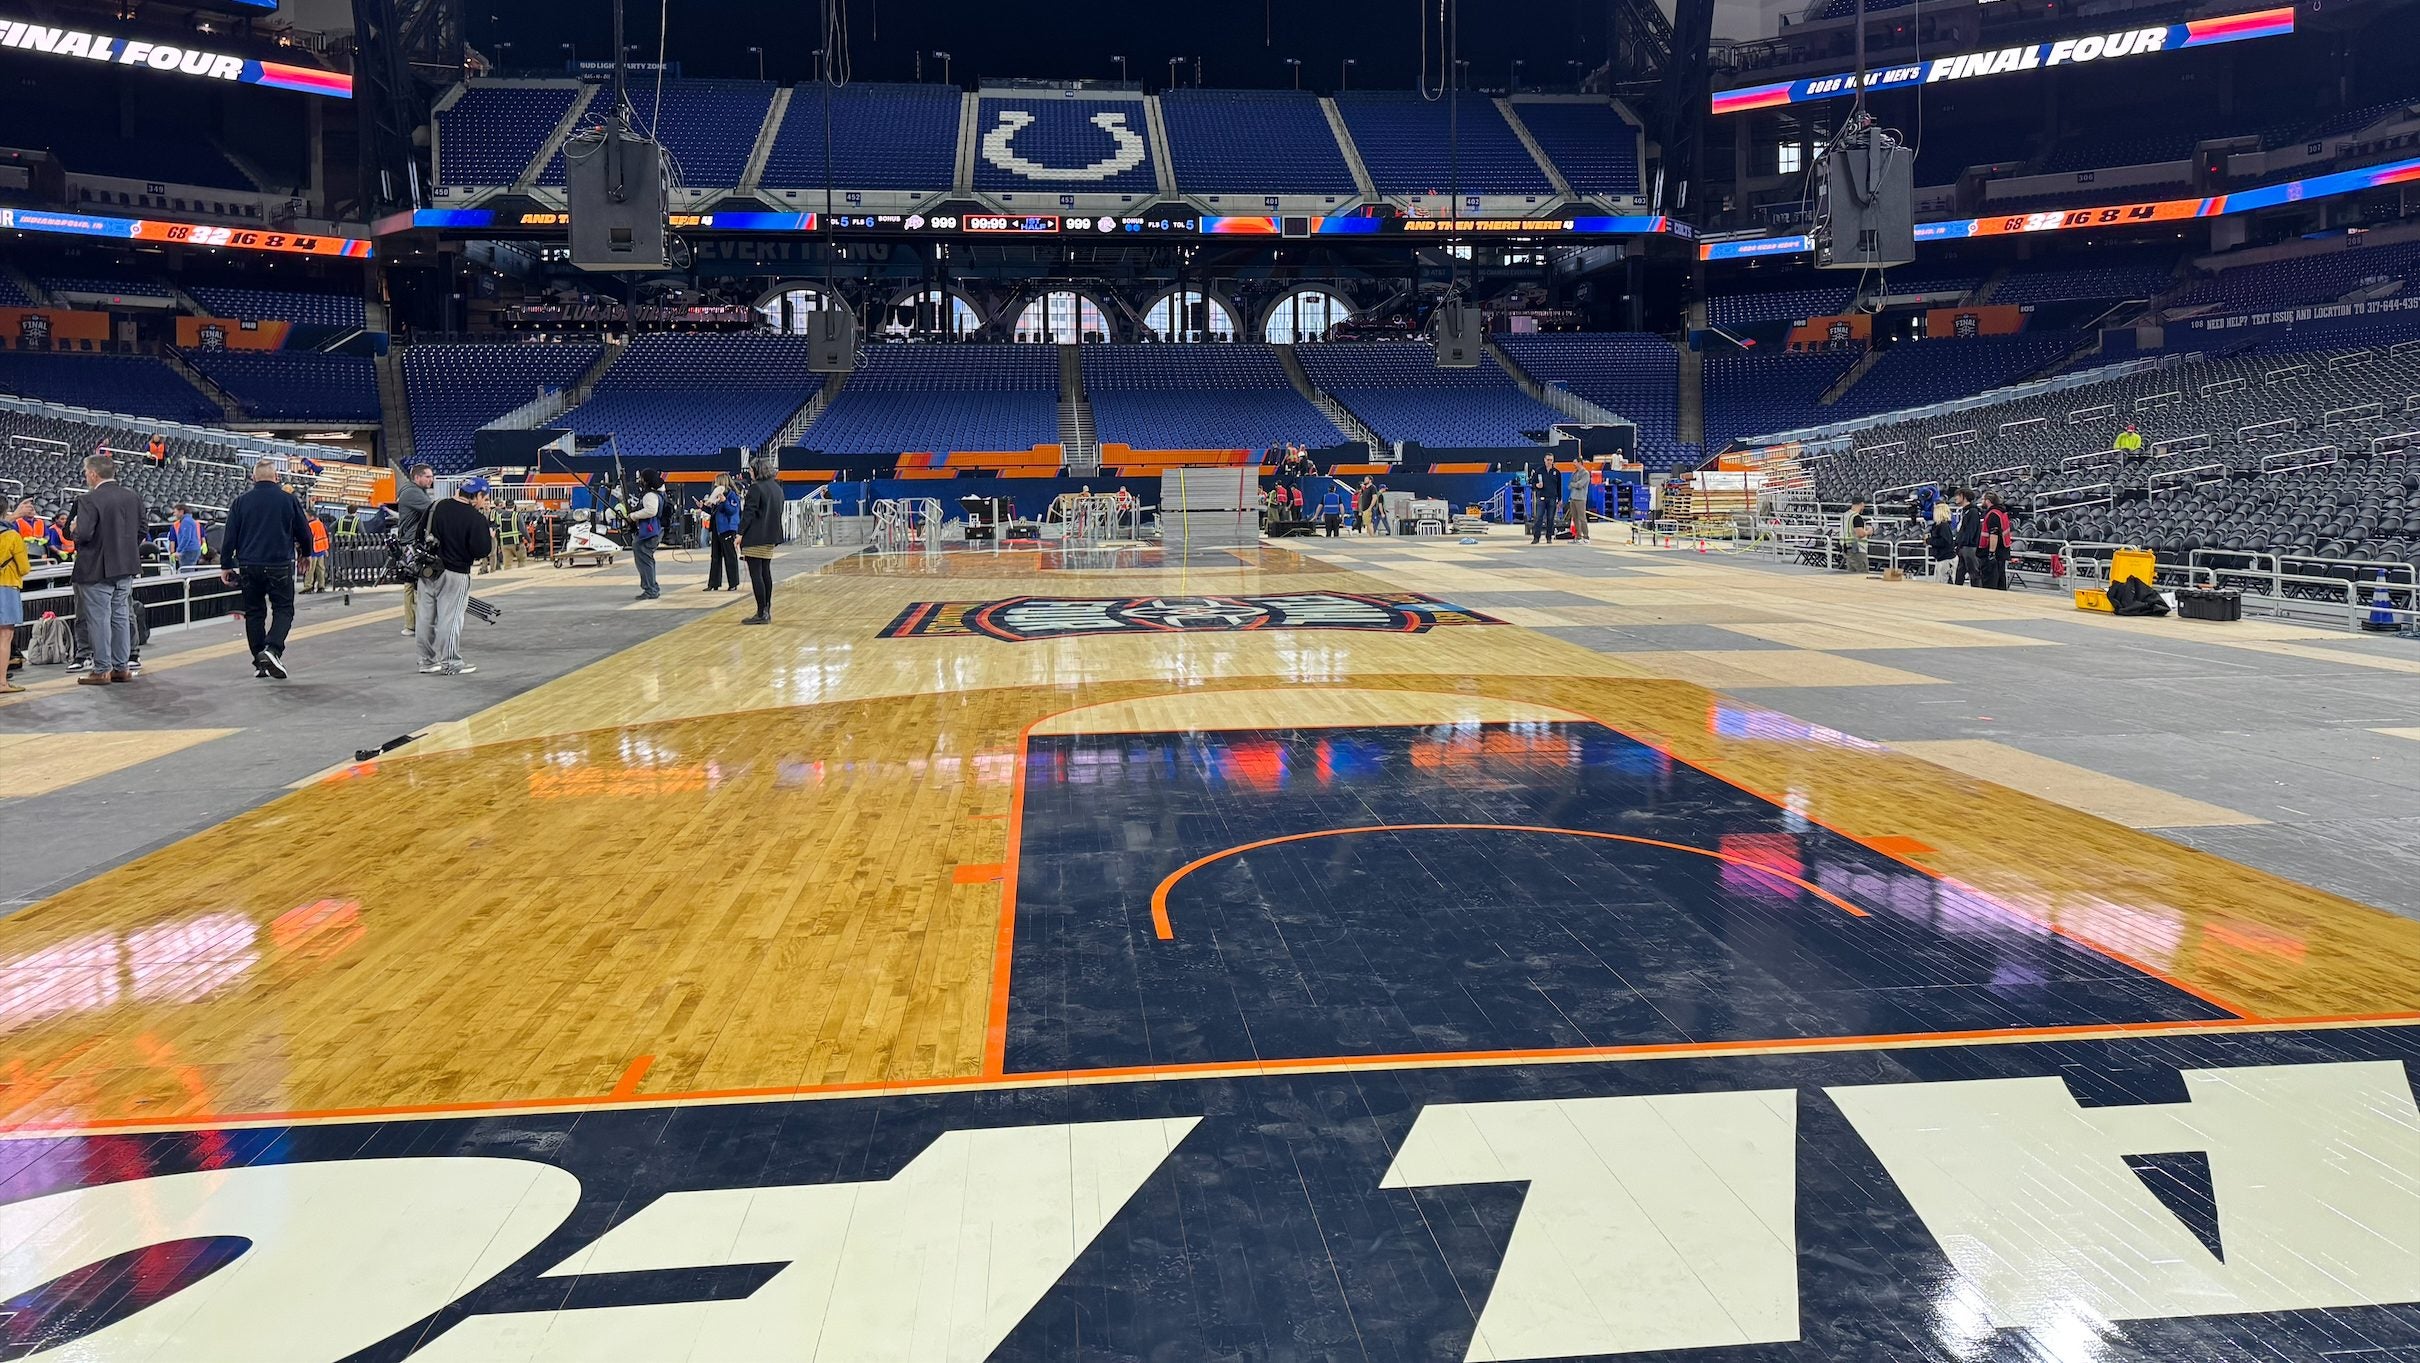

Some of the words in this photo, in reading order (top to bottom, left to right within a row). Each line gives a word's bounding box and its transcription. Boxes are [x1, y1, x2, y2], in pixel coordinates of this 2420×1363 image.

[1882, 66, 1922, 83] MEN'S
[1926, 45, 2042, 83] FINAL
[2045, 26, 2168, 66] FOUR
[119, 40, 243, 80] FOUR
[2078, 173, 2094, 182] 306
[434, 187, 448, 197] 450
[846, 193, 861, 201] 452
[1061, 196, 1074, 204] 453
[1266, 197, 1278, 205] 401
[1634, 197, 1646, 205] 403
[520, 214, 556, 224] AND
[700, 216, 713, 226] 4
[840, 217, 849, 227] 5
[866, 217, 874, 227] 6
[931, 217, 957, 228] 999
[971, 218, 1007, 229] 99:99
[1066, 218, 1091, 229] 999
[2004, 218, 2023, 231] 68
[2023, 212, 2064, 231] 32
[2064, 211, 2092, 226] 16
[2098, 209, 2120, 222] 8
[2128, 206, 2155, 219] 4
[1161, 220, 1169, 230] 6
[1186, 220, 1194, 230] 5
[1404, 221, 1436, 230] AND
[1437, 221, 1474, 230] THEN
[1475, 221, 1521, 230] THERE
[1522, 221, 1563, 230] WERE
[1563, 220, 1574, 230] 4
[1674, 223, 1692, 238] COLTS
[167, 227, 188, 239] 68
[187, 227, 231, 245] 32
[231, 233, 258, 245] 16
[265, 236, 285, 247] 8
[292, 238, 317, 249] 4
[2191, 321, 2204, 330] 108
[2206, 319, 2225, 330] NEED
[2226, 318, 2248, 329] HELP?
[2252, 314, 2271, 325] TEXT
[2272, 312, 2295, 324] ISSUE
[2296, 309, 2312, 321] AND
[2313, 304, 2353, 320] LOCATION
[2354, 302, 2365, 314] TO
[21, 322, 48, 331] FINAL
[1955, 318, 1976, 328] FINAL
[201, 330, 224, 340] FINAL
[1829, 327, 1849, 336] FINAL
